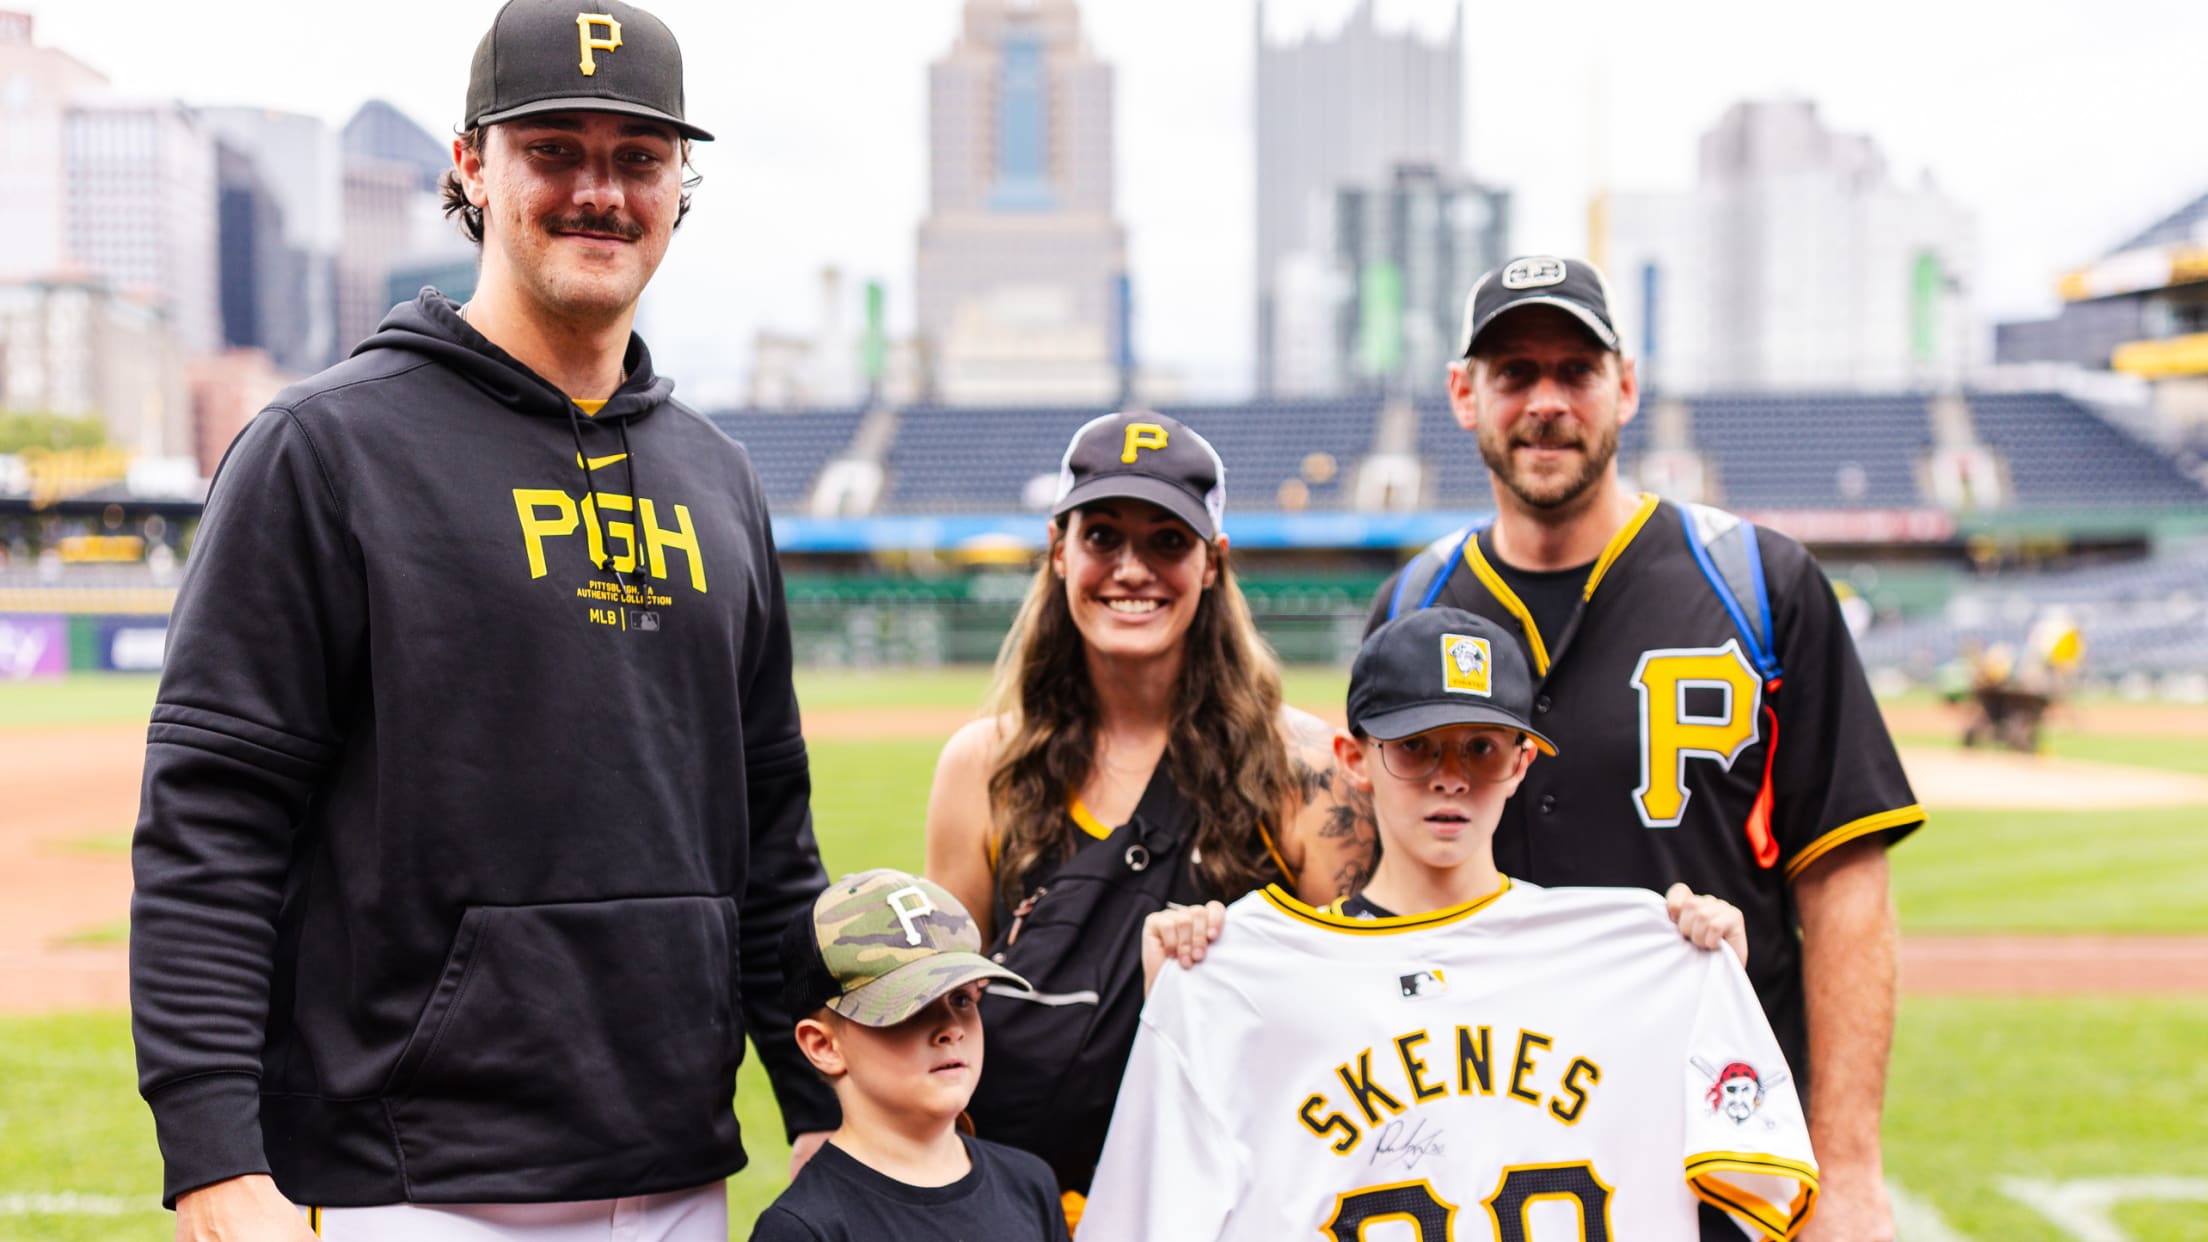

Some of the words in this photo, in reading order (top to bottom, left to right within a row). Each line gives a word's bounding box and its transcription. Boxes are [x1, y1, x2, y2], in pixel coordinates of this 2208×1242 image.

[576, 12, 623, 76] P
[1121, 423, 1167, 464] P
[512, 488, 707, 593] PGH
[576, 587, 619, 603] AUTHENTIC
[589, 580, 640, 596] PITTSBUGH,
[589, 608, 617, 625] MLB
[1630, 638, 1763, 829] P
[886, 885, 935, 947] P
[1298, 1024, 1602, 1155] SKENES
